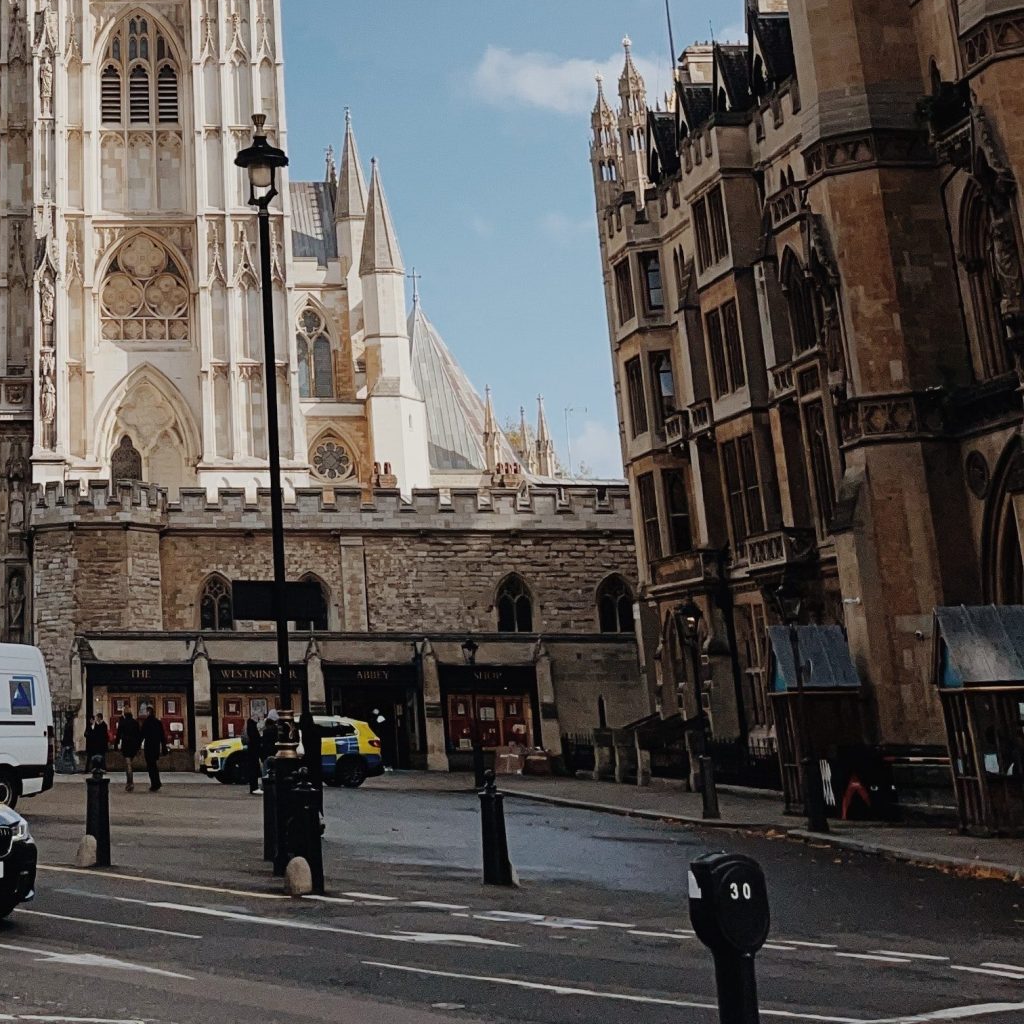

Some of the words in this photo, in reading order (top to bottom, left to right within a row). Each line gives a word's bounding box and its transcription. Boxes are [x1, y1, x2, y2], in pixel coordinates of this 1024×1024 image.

[130, 669, 151, 679] THE
[357, 670, 389, 680] ABBEY
[729, 882, 752, 900] 30
